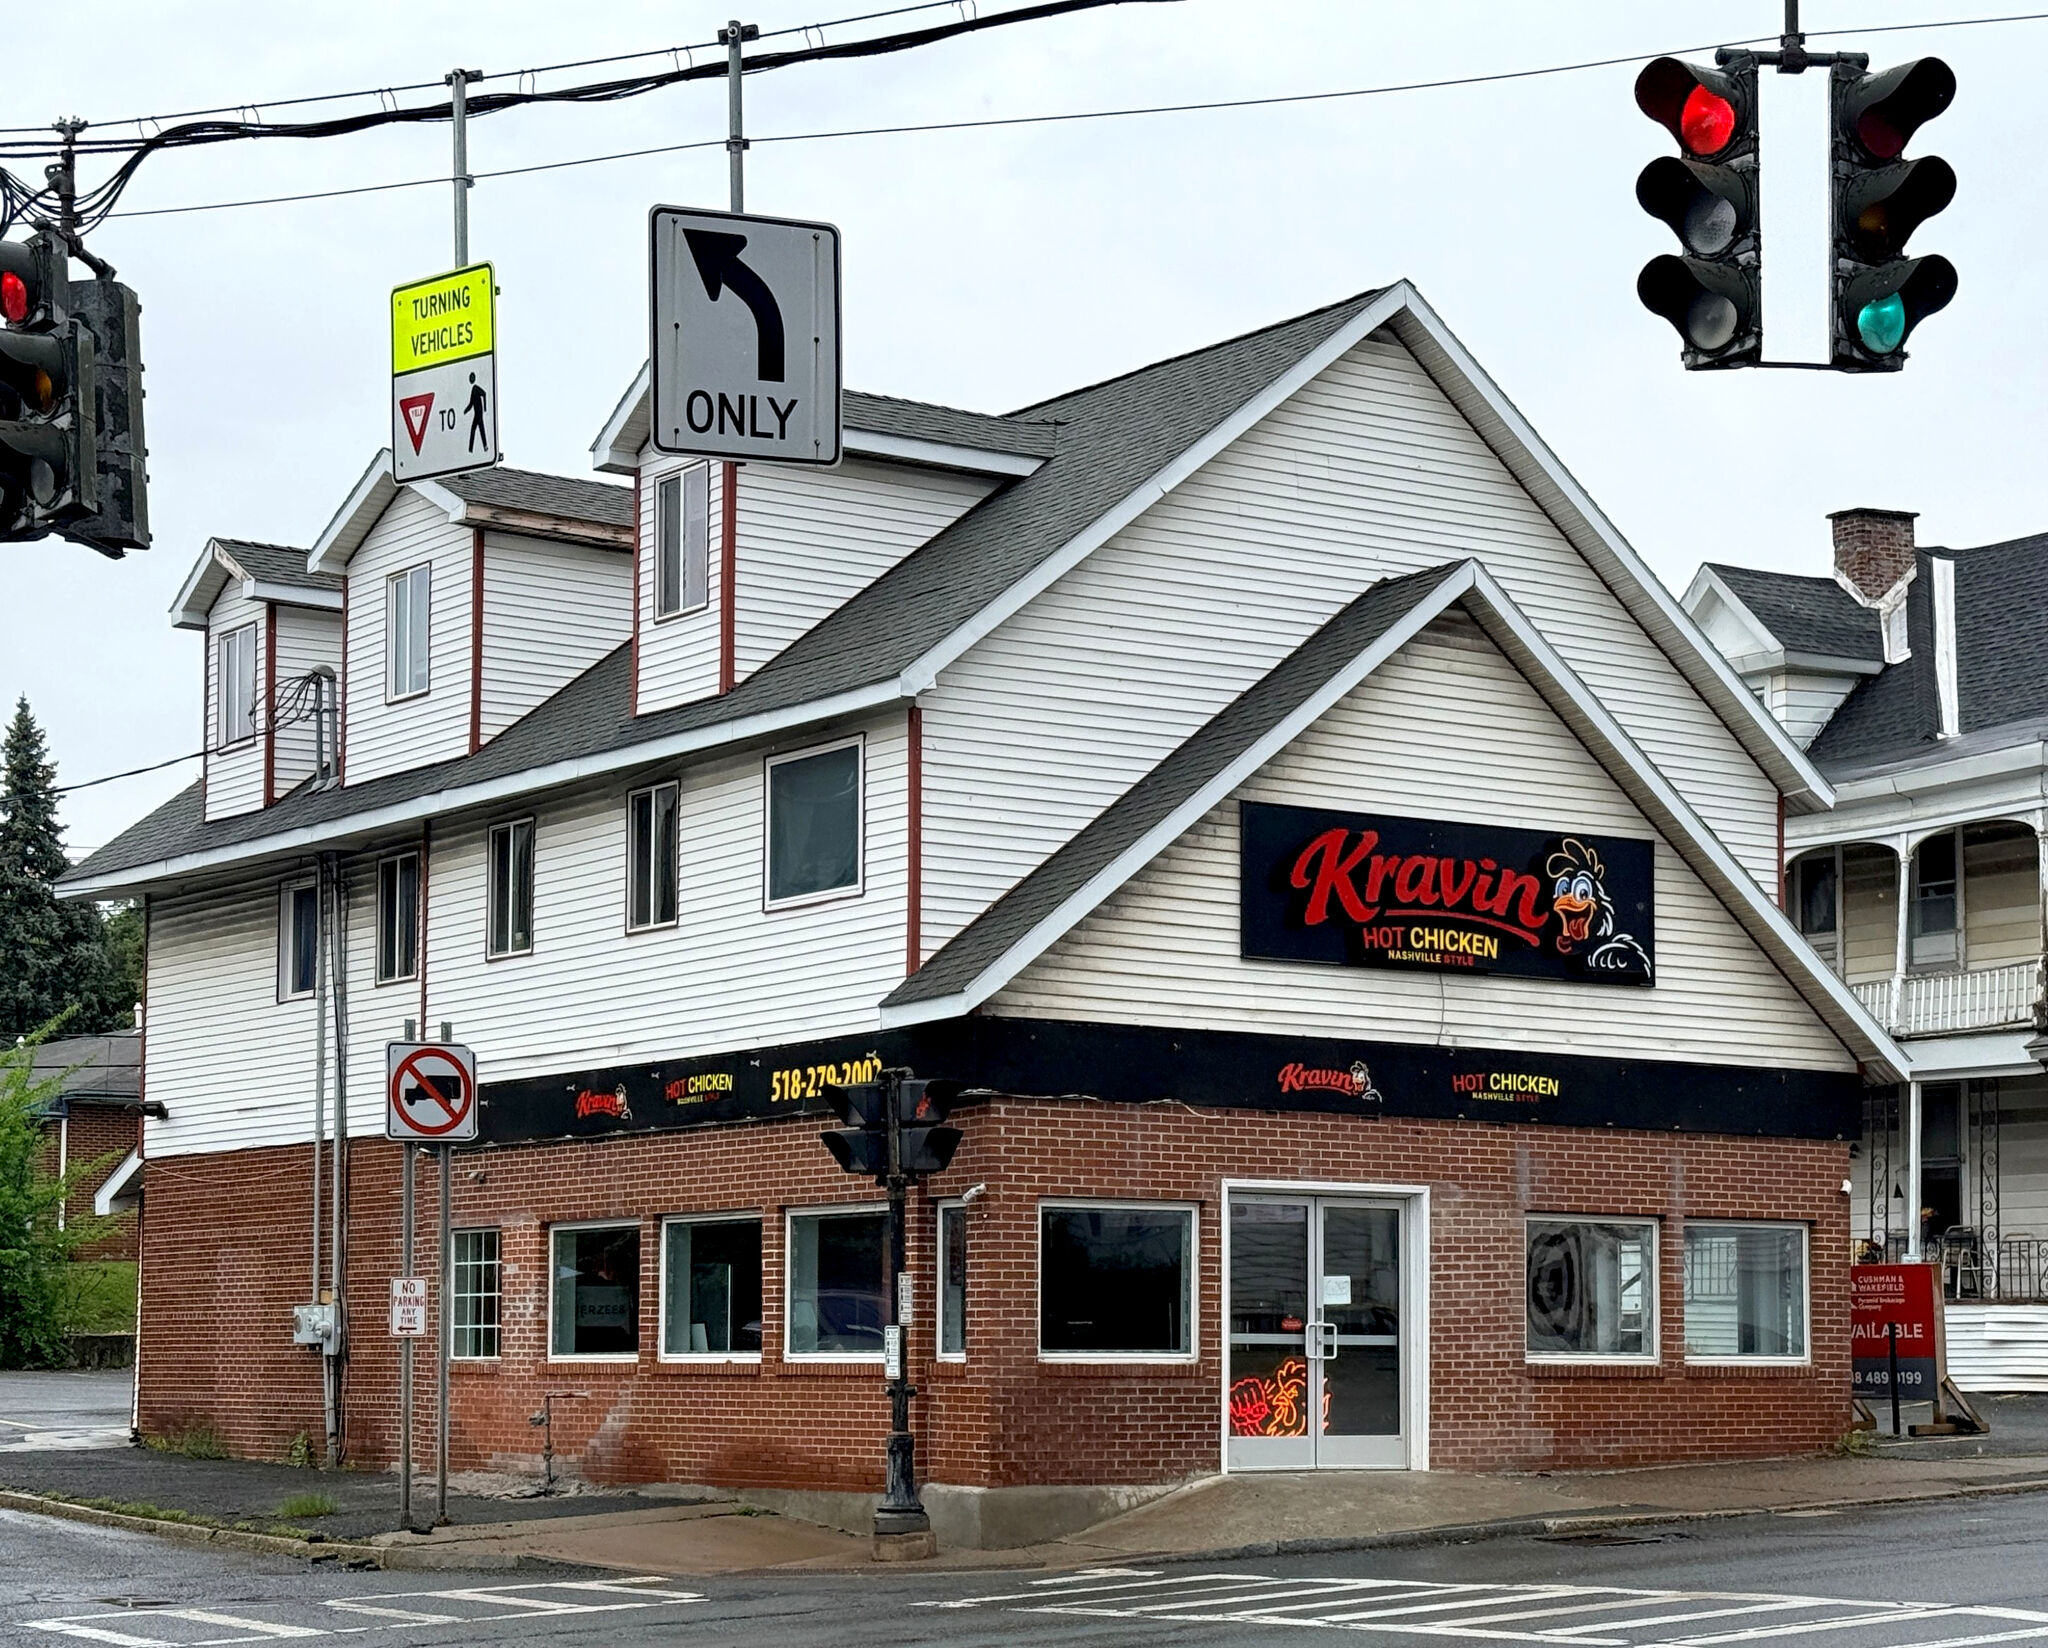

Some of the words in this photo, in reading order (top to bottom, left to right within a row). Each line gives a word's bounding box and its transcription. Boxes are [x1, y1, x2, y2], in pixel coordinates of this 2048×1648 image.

[412, 285, 470, 321] TURNING
[411, 321, 473, 357] VEHICLES
[439, 408, 455, 432] TO
[686, 390, 799, 440] ONLY
[1290, 828, 1549, 929] Kravin
[1363, 927, 1406, 949] HOT
[1410, 927, 1498, 959] CHICKEN
[1388, 950, 1442, 963] NASHVILLE
[1443, 954, 1474, 966] STYLE
[665, 1079, 687, 1101] HOT
[688, 1074, 733, 1093] CHICKEN
[1278, 1063, 1354, 1093] Kravin
[1452, 1074, 1486, 1092] HOT
[1490, 1073, 1559, 1096] CHICKEN
[1472, 1092, 1514, 1101] NASHVILLE
[402, 1281, 416, 1294] NO
[1859, 1284, 1905, 1292] WAKEFIELD
[393, 1296, 425, 1307] PARKING
[402, 1308, 416, 1316] ANY
[400, 1316, 418, 1325] TIME
[1865, 1371, 1889, 1385] 489
